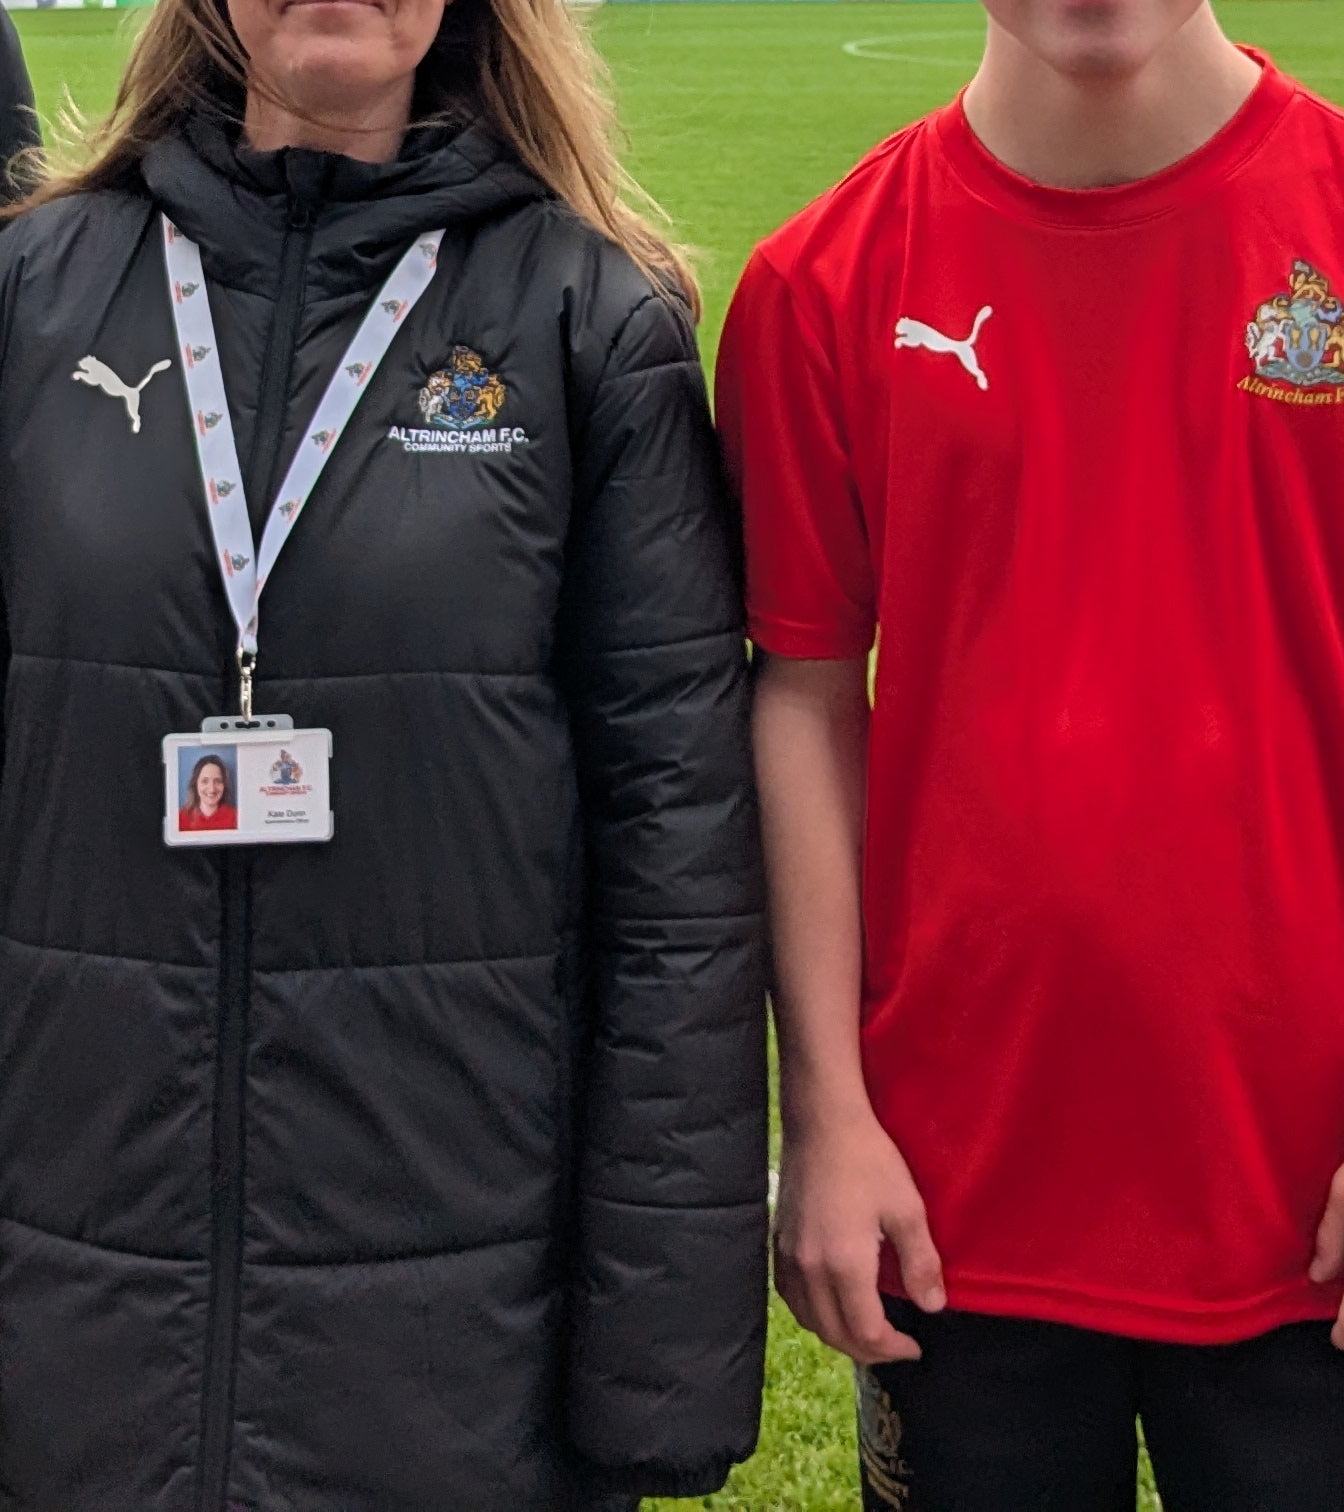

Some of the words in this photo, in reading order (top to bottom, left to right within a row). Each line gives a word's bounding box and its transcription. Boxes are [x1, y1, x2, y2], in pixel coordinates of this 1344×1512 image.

[1237, 375, 1333, 405] Altrincham
[388, 425, 496, 444] ALTRINCHAM
[500, 426, 530, 443] F.C.
[403, 441, 467, 453] COMMUNITY
[469, 441, 512, 453] SPORTS
